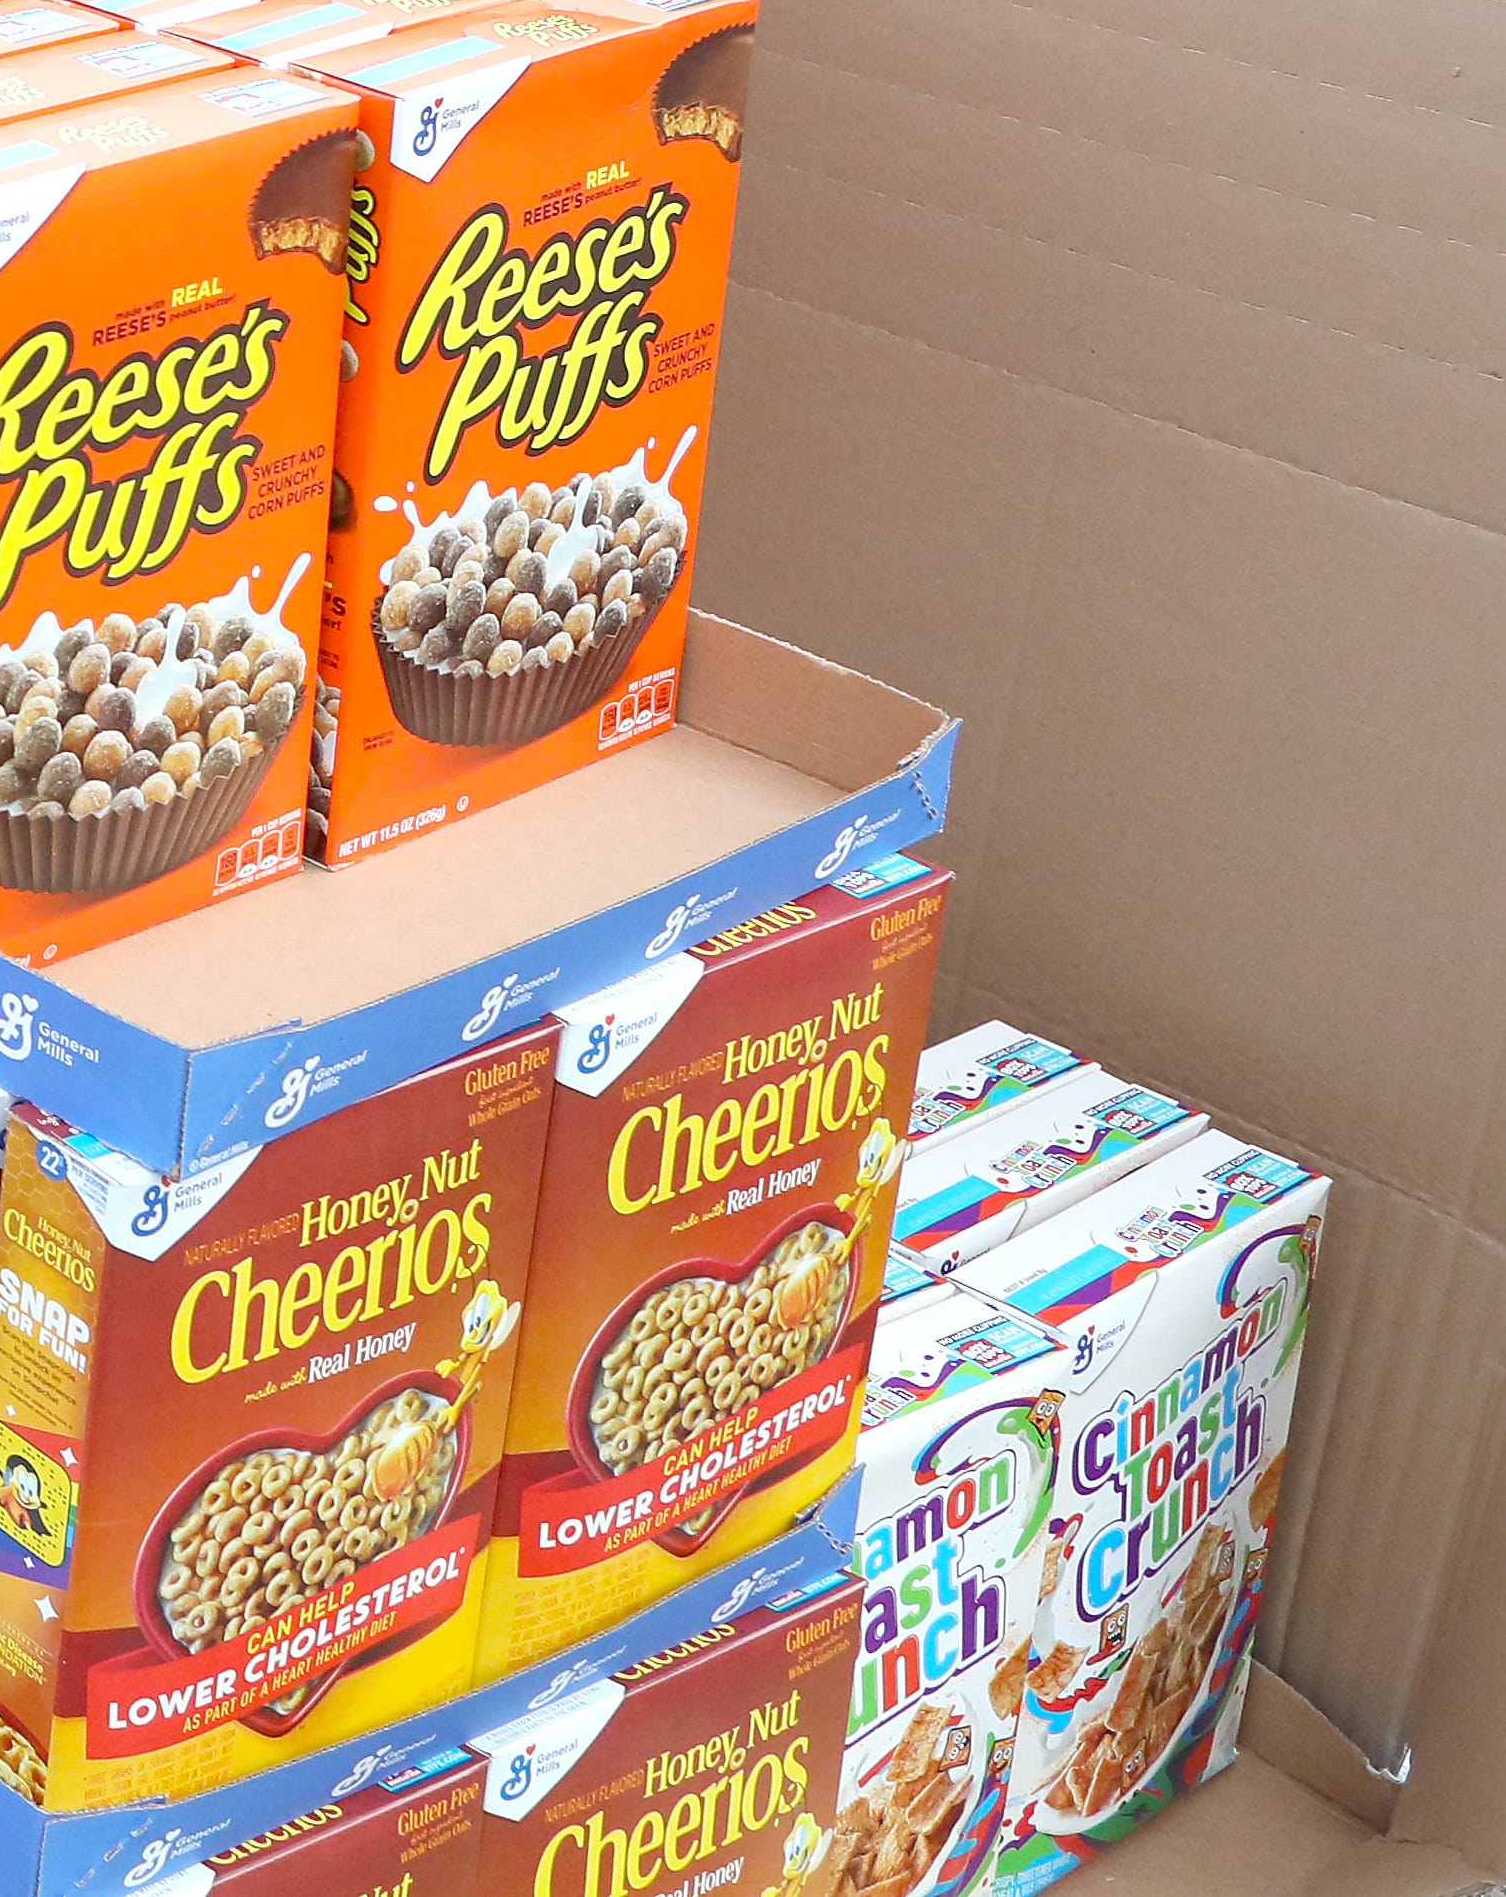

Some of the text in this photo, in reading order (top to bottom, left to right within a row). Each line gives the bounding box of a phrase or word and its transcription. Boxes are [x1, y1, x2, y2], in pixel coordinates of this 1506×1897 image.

[171, 278, 224, 308] REAL
[395, 183, 690, 374] Reese's
[92, 310, 167, 346] REESE'S
[424, 288, 664, 484] Puffs
[253, 444, 326, 480] SWEET AND
[258, 468, 317, 497] CRUNCHY
[248, 481, 325, 519] CORN PUFFS
[338, 837, 360, 858] NET
[361, 831, 378, 850] WT
[379, 823, 399, 843] 11.5
[400, 818, 414, 834] OZ
[721, 982, 884, 1084] Honey Nut
[606, 1034, 890, 1215] Cheerios
[299, 1138, 483, 1248] Honey Nut
[2, 1207, 96, 1294] Cheerios
[38, 1215, 93, 1263] Honey Nut
[170, 1192, 492, 1384] Cheerios
[39, 1323, 87, 1375] FUN!
[1123, 1366, 1242, 1518] Toast
[246, 1581, 356, 1654] CAN HELP
[107, 1668, 238, 1730] LOWER
[182, 1611, 398, 1733] AS PART OF A HEART HEALTHY DIET
